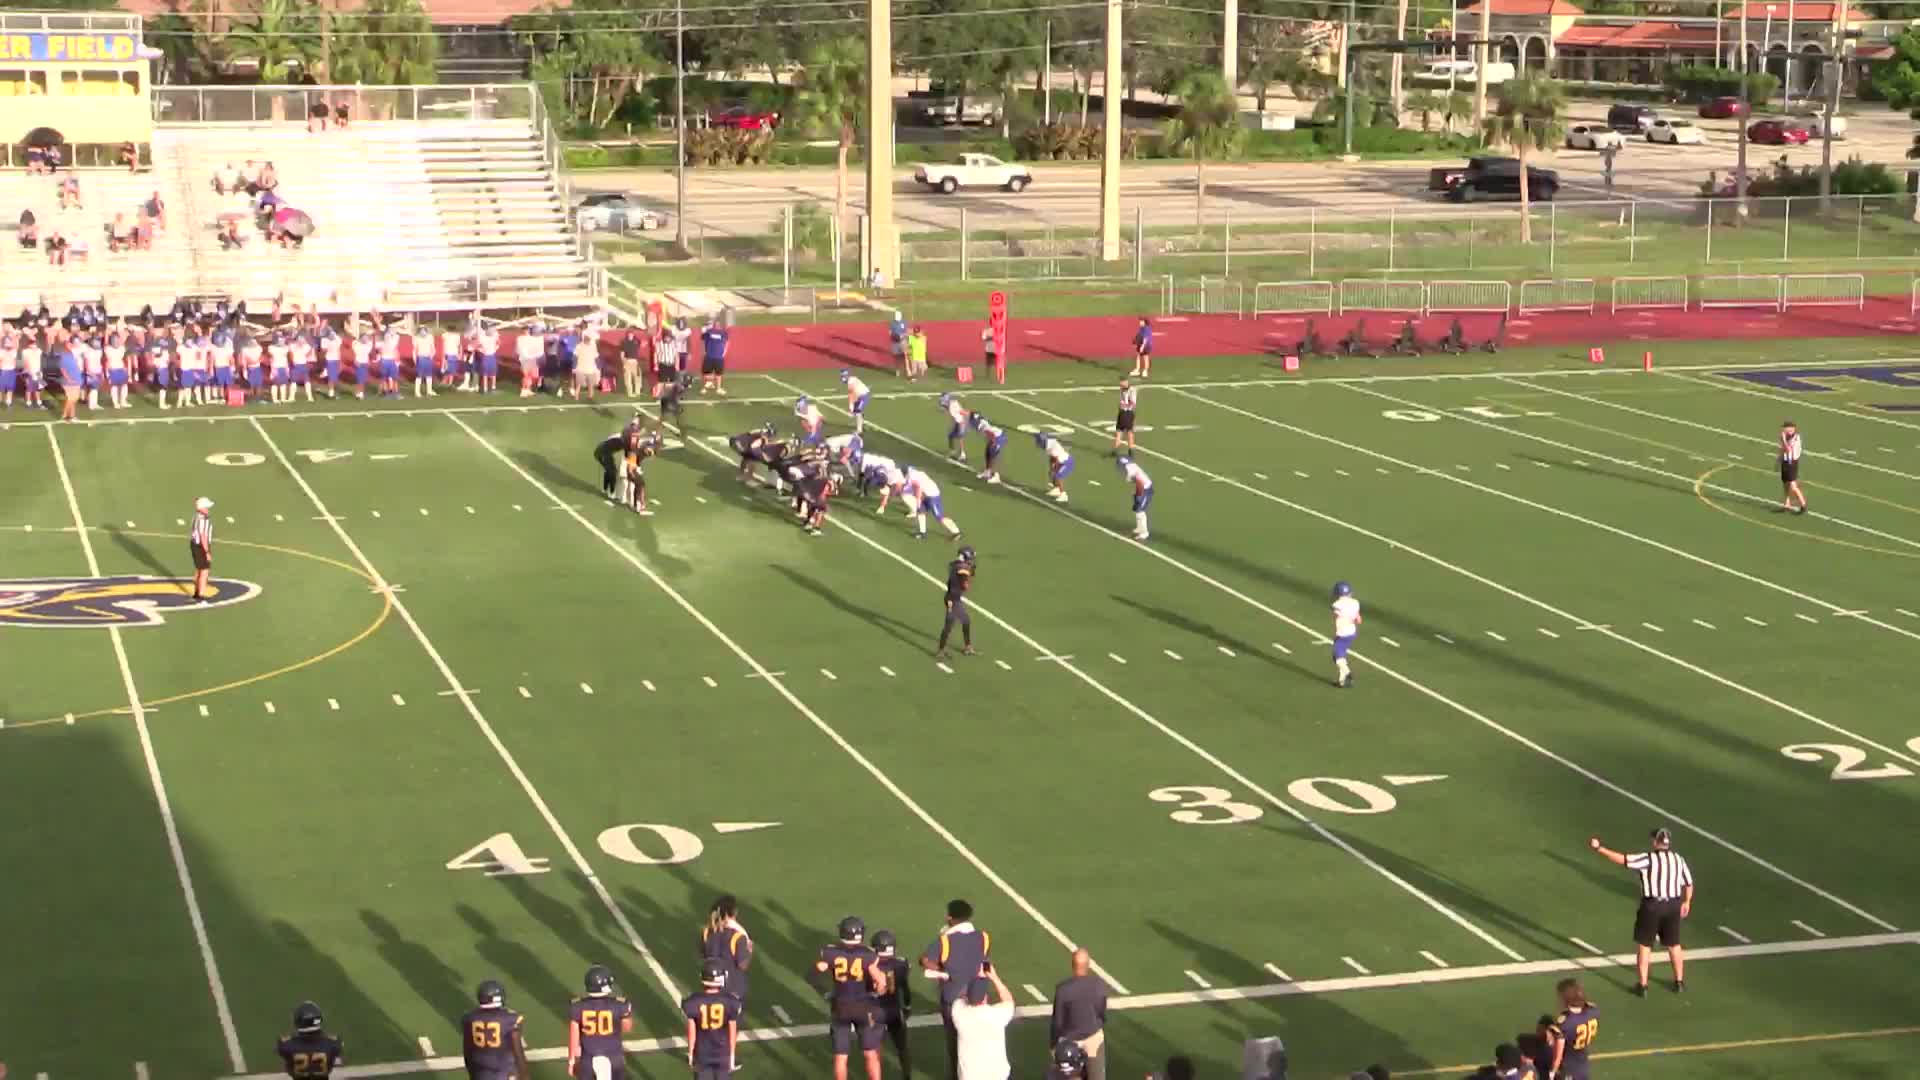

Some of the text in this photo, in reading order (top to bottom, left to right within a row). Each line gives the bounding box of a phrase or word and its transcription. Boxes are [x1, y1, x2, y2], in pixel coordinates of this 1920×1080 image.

[48, 35, 133, 59] FIELD
[1148, 777, 1396, 824] 30
[446, 824, 704, 876] 40
[833, 956, 864, 983] 24
[581, 1010, 614, 1036] 50
[699, 1003, 725, 1030] 19
[472, 1020, 501, 1048] 63
[292, 1052, 328, 1076] 23
